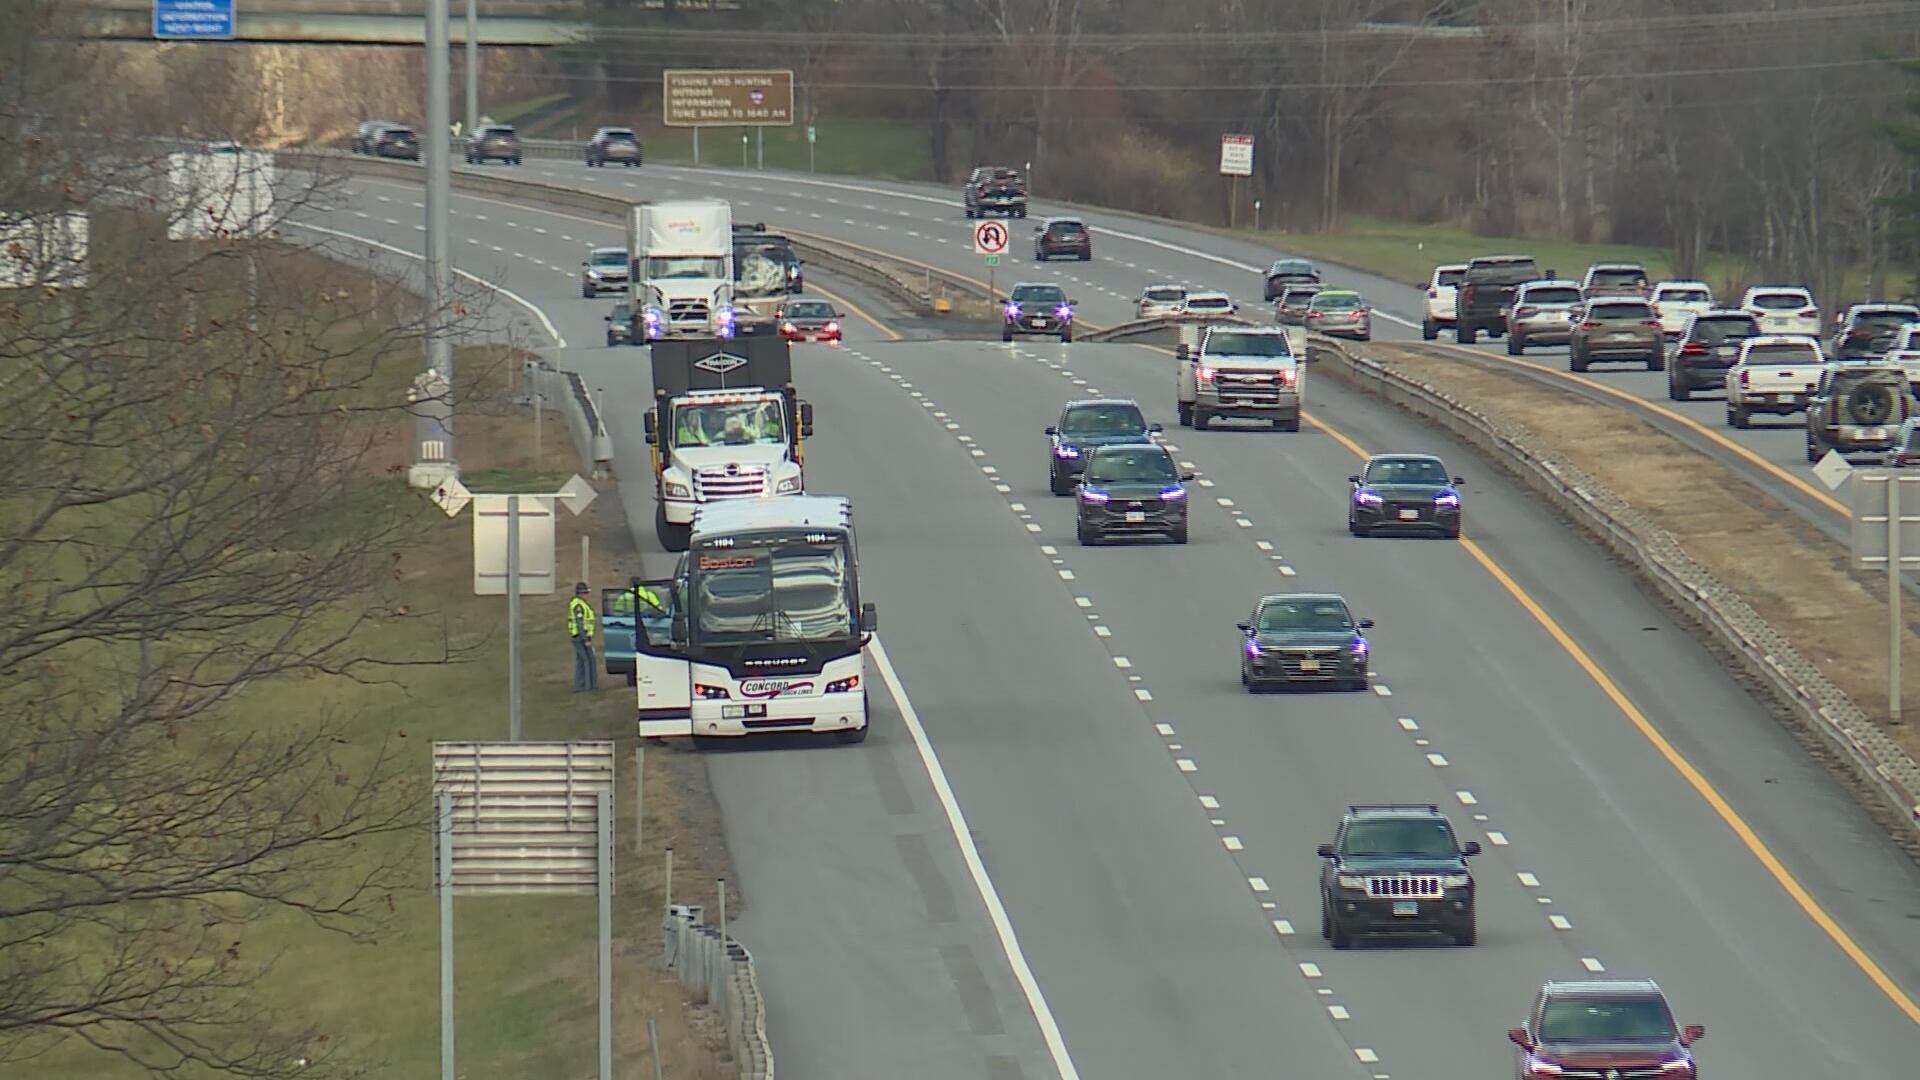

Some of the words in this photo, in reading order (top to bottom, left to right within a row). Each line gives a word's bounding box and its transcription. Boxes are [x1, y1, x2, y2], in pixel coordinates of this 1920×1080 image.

[672, 78, 708, 86] FISHING
[712, 78, 731, 86] AND
[734, 78, 773, 86] HUNTING
[672, 88, 713, 96] OUTDOOR
[672, 98, 731, 107] INFORMATION
[672, 109, 696, 118] TUNE
[700, 109, 729, 117] RADIO
[732, 109, 743, 117] TO
[772, 109, 786, 117] AM
[700, 557, 753, 570] Boston
[745, 681, 789, 692] CONCORD
